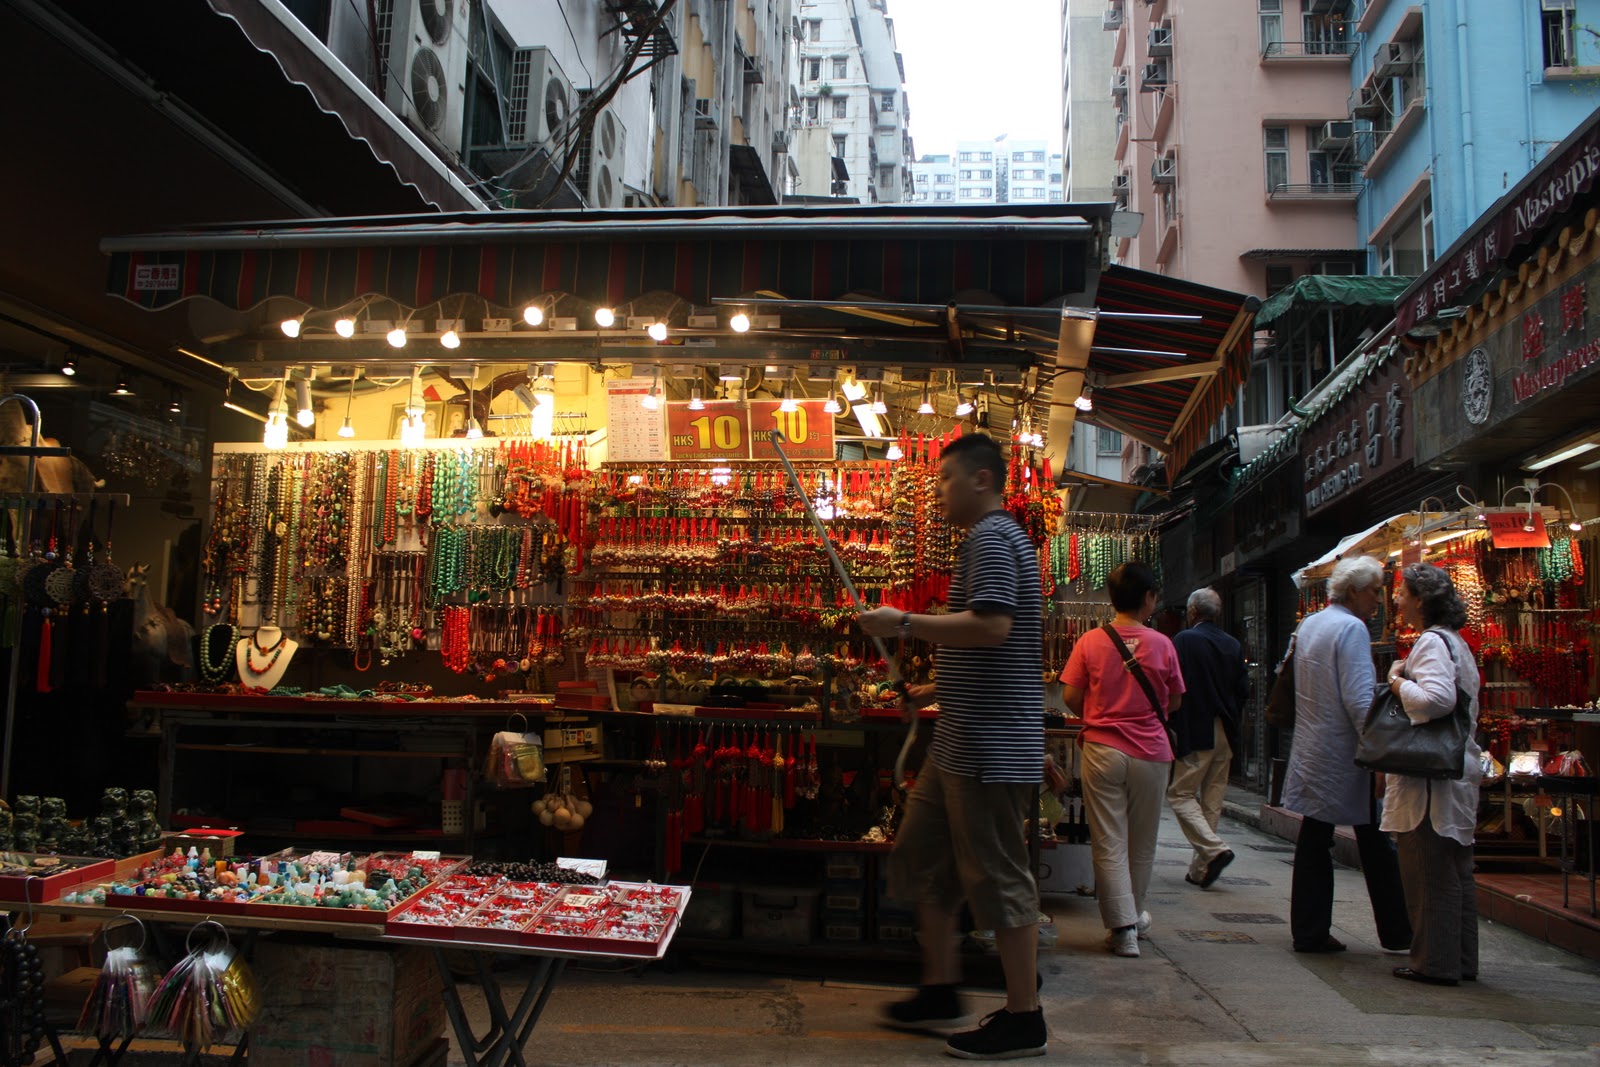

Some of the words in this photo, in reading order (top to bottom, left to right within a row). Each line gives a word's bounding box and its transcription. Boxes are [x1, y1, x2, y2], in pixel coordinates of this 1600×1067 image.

[1513, 337, 1600, 405] Masterpieces
[690, 414, 742, 451] 10
[770, 405, 810, 445] 10
[675, 452, 693, 460] Lucky
[708, 451, 745, 459] Accessories
